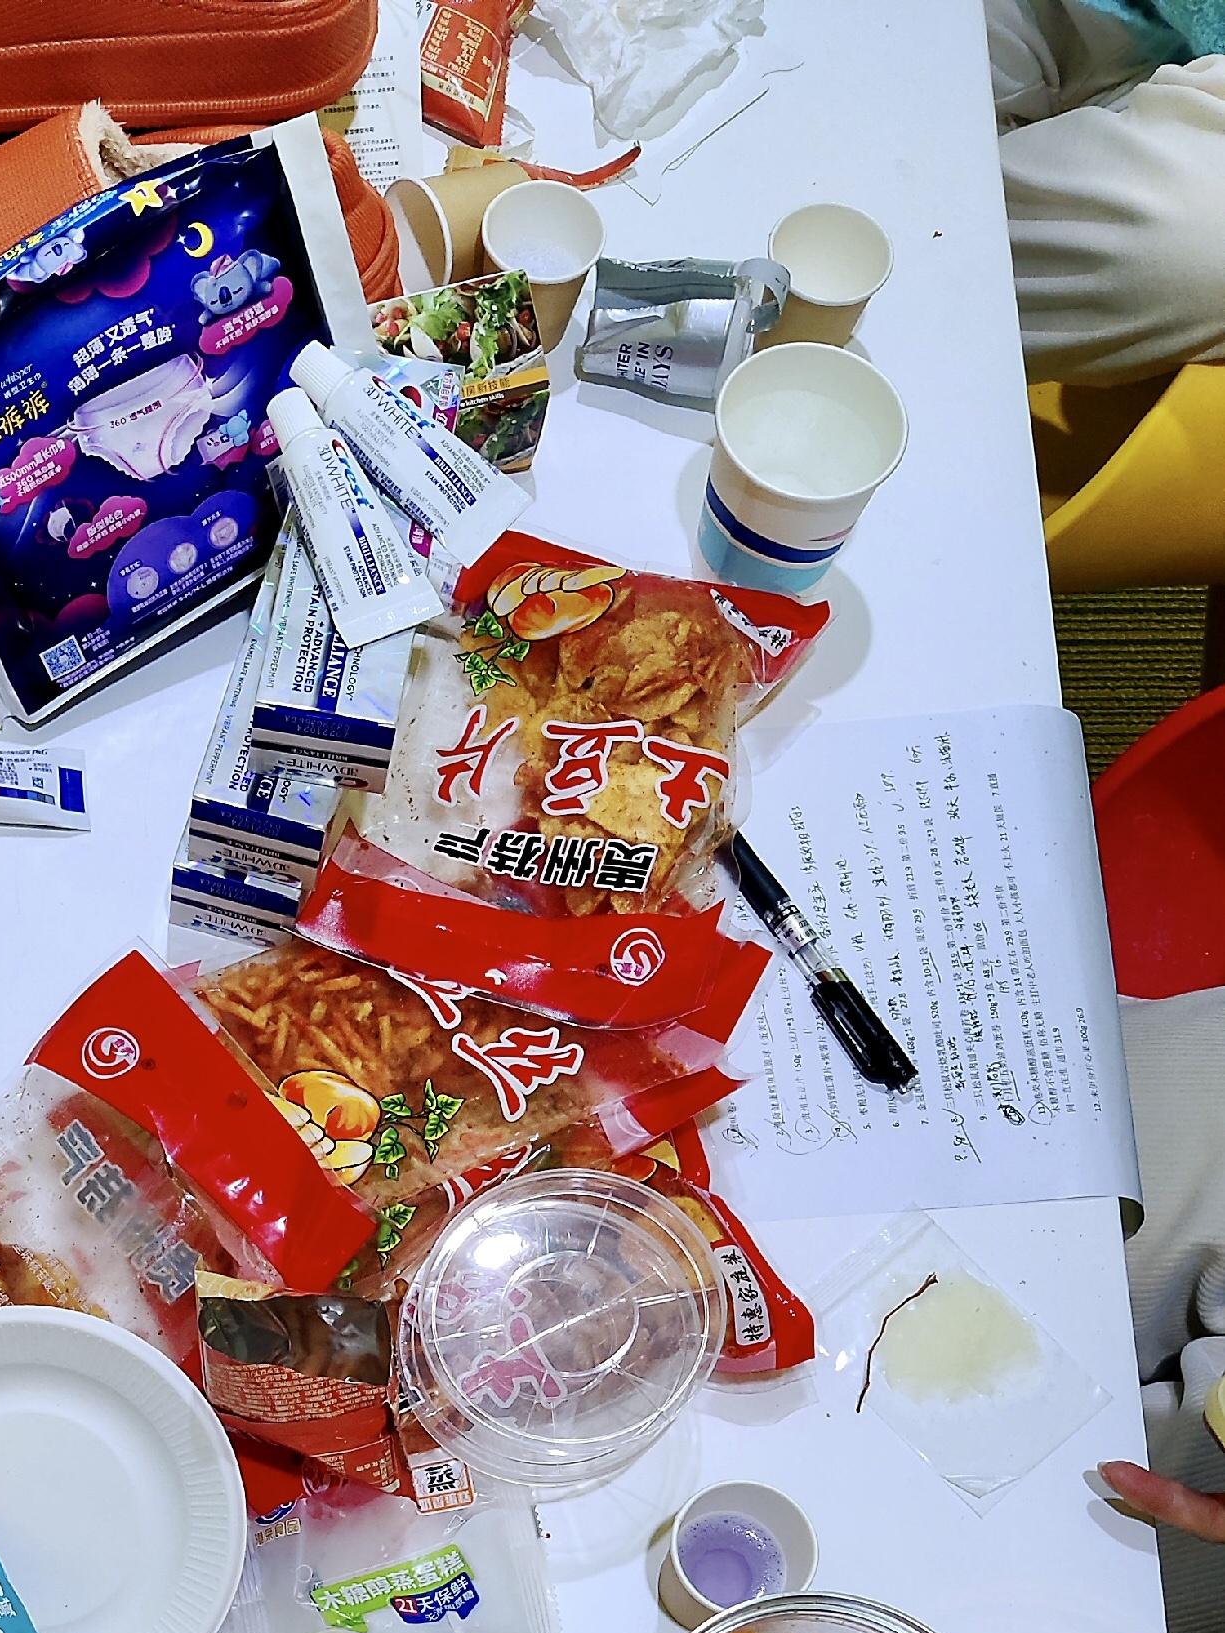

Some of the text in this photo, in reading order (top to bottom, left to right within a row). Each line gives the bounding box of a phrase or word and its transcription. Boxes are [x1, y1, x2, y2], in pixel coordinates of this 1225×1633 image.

[614, 342, 633, 377] HITER
[329, 435, 373, 509] Crest
[432, 455, 476, 504] BRILLIANCE
[342, 545, 368, 599] STAIN PROTECTION
[355, 535, 386, 593] BRILLIANCE
[356, 564, 374, 596] ADVANCED
[291, 584, 323, 692] STAIN PROTECTION
[303, 630, 323, 693] ADVANCED
[320, 632, 347, 699] LLIANCE
[344, 645, 362, 698] CHNOLOGY
[434, 704, 731, 829] 土豆片
[434, 829, 661, 894] 贵州特产
[425, 1464, 458, 1494] 蒸
[319, 1551, 465, 1611] 木糖醇蒸蛋糕
[394, 1576, 472, 1614] 21天保鲜
